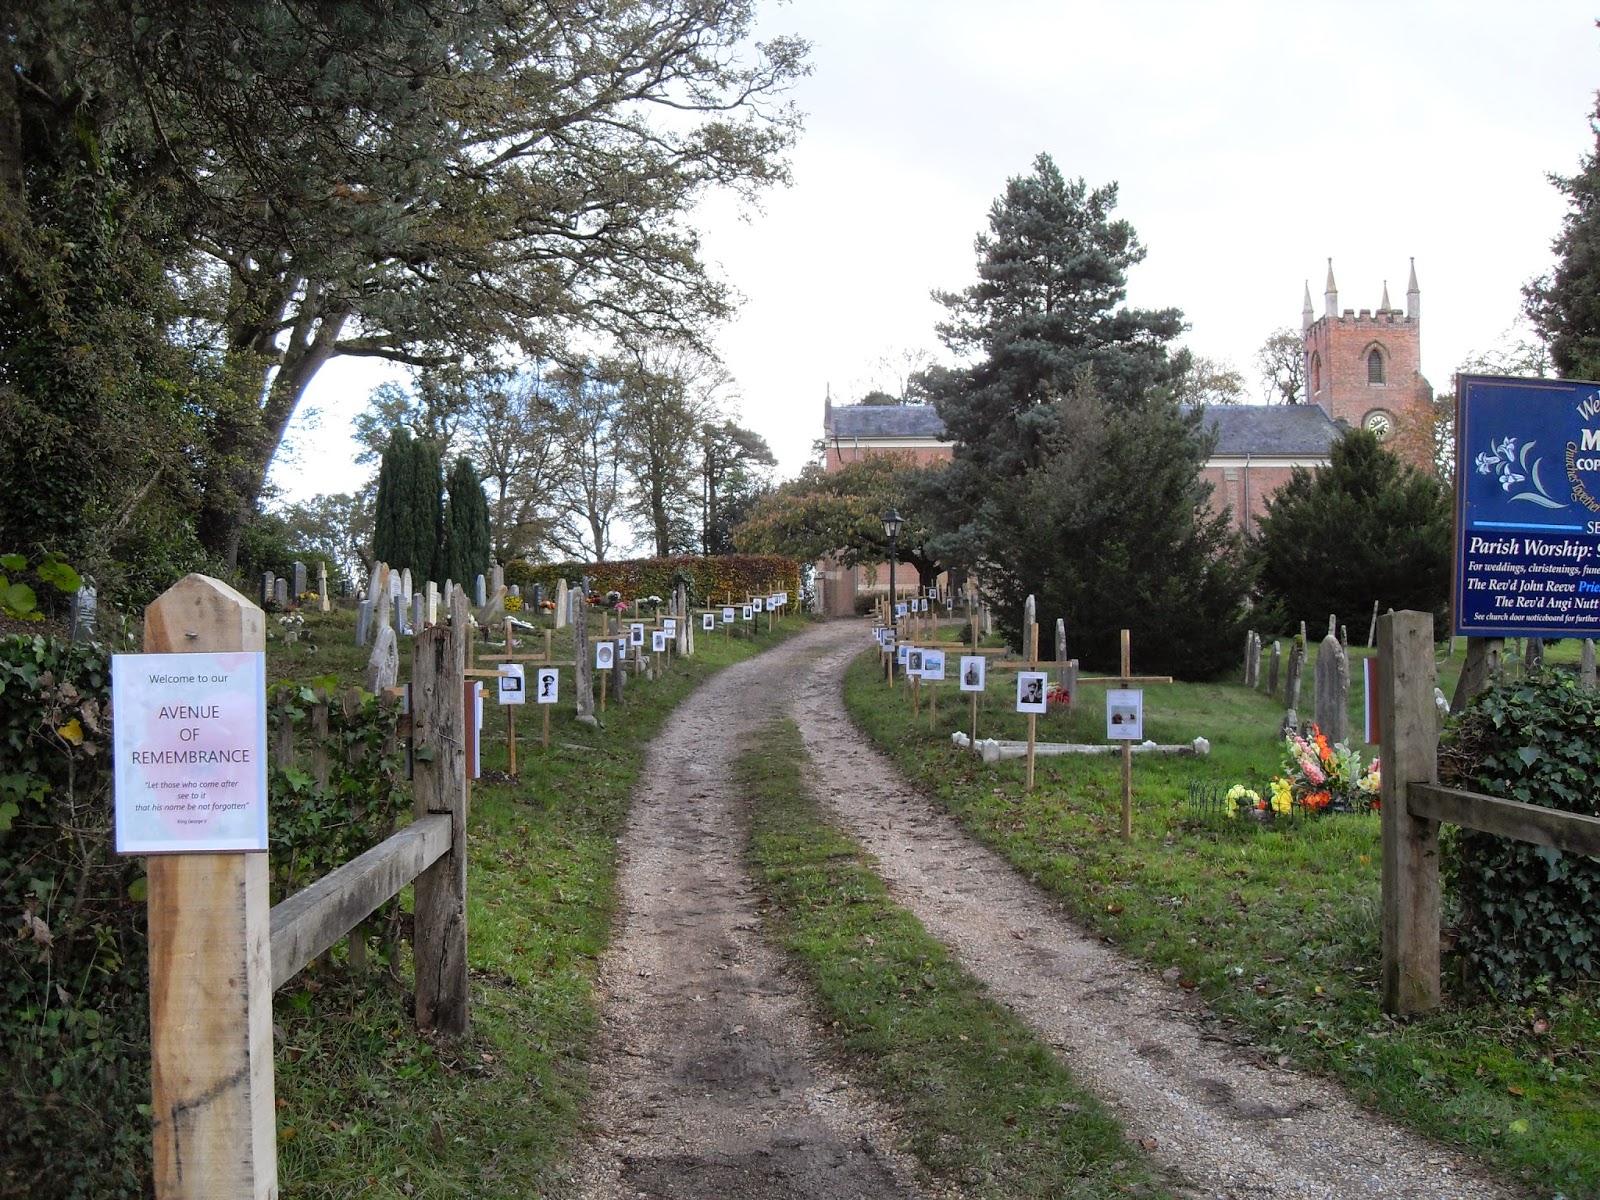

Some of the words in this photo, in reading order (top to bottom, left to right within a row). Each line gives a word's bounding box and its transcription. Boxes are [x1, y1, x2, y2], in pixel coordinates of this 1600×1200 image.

[1565, 441, 1578, 483] Churches
[1469, 536, 1519, 555] Parish
[1524, 538, 1593, 562] Worship:
[1468, 560, 1483, 571] For
[1484, 562, 1527, 575] weddings,
[1528, 563, 1581, 576] christenings,
[1467, 577, 1487, 590] The
[1488, 578, 1518, 591] Rev'd
[1519, 579, 1544, 593] John
[1545, 580, 1576, 592] Reeve
[1578, 580, 1600, 593] Prie
[1494, 595, 1514, 608] The
[1515, 596, 1545, 608] Rev'd
[1546, 597, 1573, 612] Angi
[1573, 597, 1599, 609] Nutt
[1473, 611, 1485, 621] See
[1486, 612, 1508, 621] church
[1509, 613, 1525, 621] door
[1526, 613, 1565, 622] noticeboard
[1564, 614, 1575, 624] for
[1575, 614, 1598, 624] further
[149, 674, 195, 684] Welcome
[198, 674, 208, 683] to
[211, 675, 228, 683] our
[159, 705, 219, 720] AVENUE
[179, 728, 200, 741] OF
[132, 749, 250, 764] REMEMBRANCE
[160, 781, 181, 789] those
[182, 780, 198, 788] who
[220, 780, 239, 788] after
[200, 791, 207, 799] it
[135, 803, 150, 811] that
[151, 803, 163, 811] his
[187, 803, 197, 811] be
